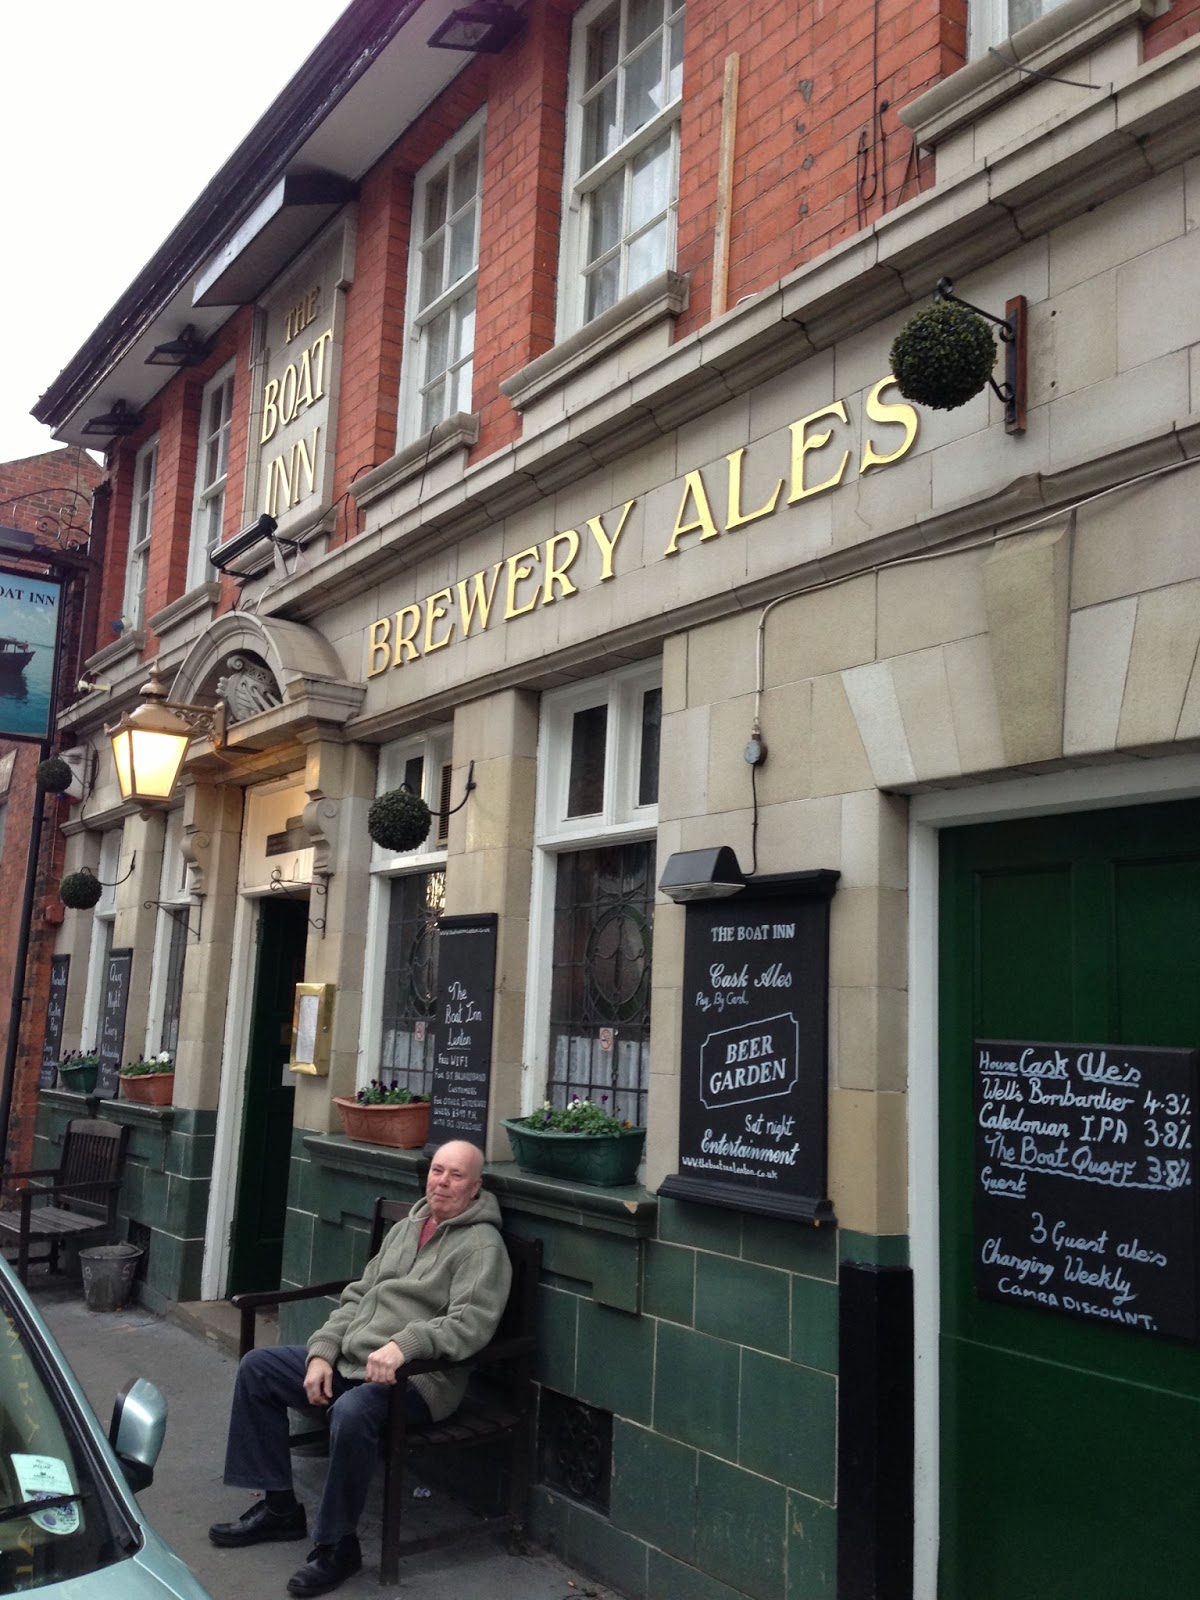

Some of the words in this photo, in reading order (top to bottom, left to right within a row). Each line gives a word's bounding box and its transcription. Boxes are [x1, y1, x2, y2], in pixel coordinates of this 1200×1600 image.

[285, 286, 320, 344] THE
[260, 328, 333, 445] BOAT
[264, 426, 320, 518] INN
[367, 500, 635, 678] BREWERY
[663, 374, 919, 557] ALES
[29, 592, 56, 606] INN
[711, 926, 735, 942] THE
[738, 925, 769, 941] BOAT
[772, 923, 796, 939] INN
[448, 981, 467, 1000] The
[709, 963, 749, 988] Cask
[753, 962, 792, 988] Ales
[445, 1004, 462, 1024] Boat
[465, 1001, 482, 1022] Inn
[695, 991, 712, 1012] Pay
[713, 991, 725, 1012] By
[725, 1035, 774, 1065] BEER
[979, 1050, 1019, 1072] House
[1019, 1048, 1069, 1078] Cask
[709, 1058, 786, 1094] GARDEN
[1028, 1077, 1135, 1112] Bombardier
[1143, 1090, 1192, 1115] 4.3%
[745, 1113, 763, 1133] Sat
[766, 1114, 795, 1142] night
[978, 1102, 1070, 1138] Caledonian
[1143, 1119, 1192, 1150] 3.8%
[701, 1128, 799, 1165] Entertainment
[985, 1132, 1016, 1162] The
[1020, 1136, 1068, 1168] Boat
[1146, 1156, 1192, 1188] 3.8%
[981, 1167, 1026, 1192] Guest
[1030, 1212, 1047, 1244] 3
[1052, 1221, 1109, 1252] Guest
[981, 1238, 1054, 1286] Changing
[1064, 1256, 1136, 1306] Weekly
